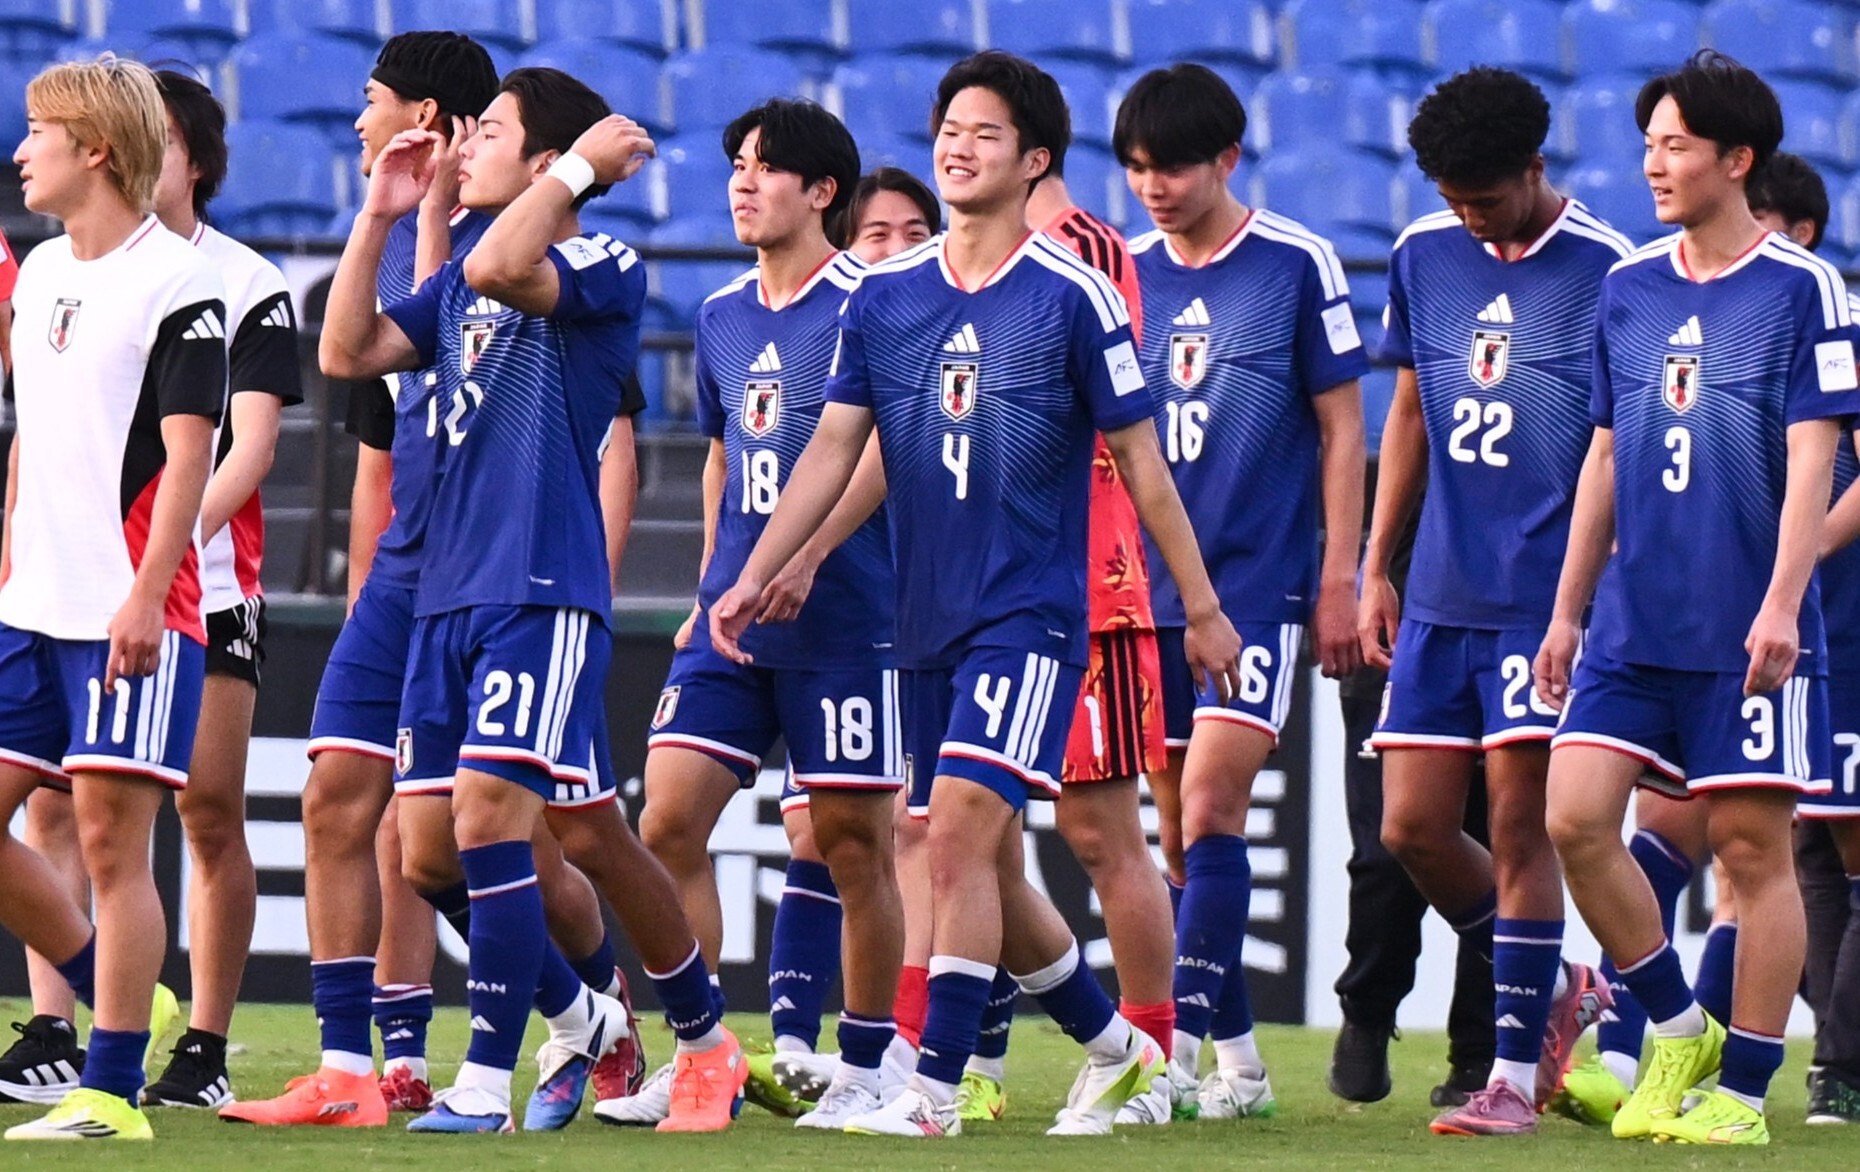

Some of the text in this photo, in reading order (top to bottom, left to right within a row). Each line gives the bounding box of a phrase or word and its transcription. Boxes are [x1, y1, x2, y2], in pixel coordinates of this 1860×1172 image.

[1166, 400, 1209, 463] 16
[1448, 396, 1514, 467] 22
[1662, 426, 1692, 492] 3
[741, 449, 780, 515] 18
[942, 433, 971, 500] 4
[85, 677, 131, 745] 11
[476, 670, 536, 738] 21
[821, 696, 873, 762] 18
[974, 673, 1012, 739] 4
[1084, 695, 1104, 757] 1
[1741, 696, 1775, 761] 3
[1175, 956, 1225, 976] JAPAN
